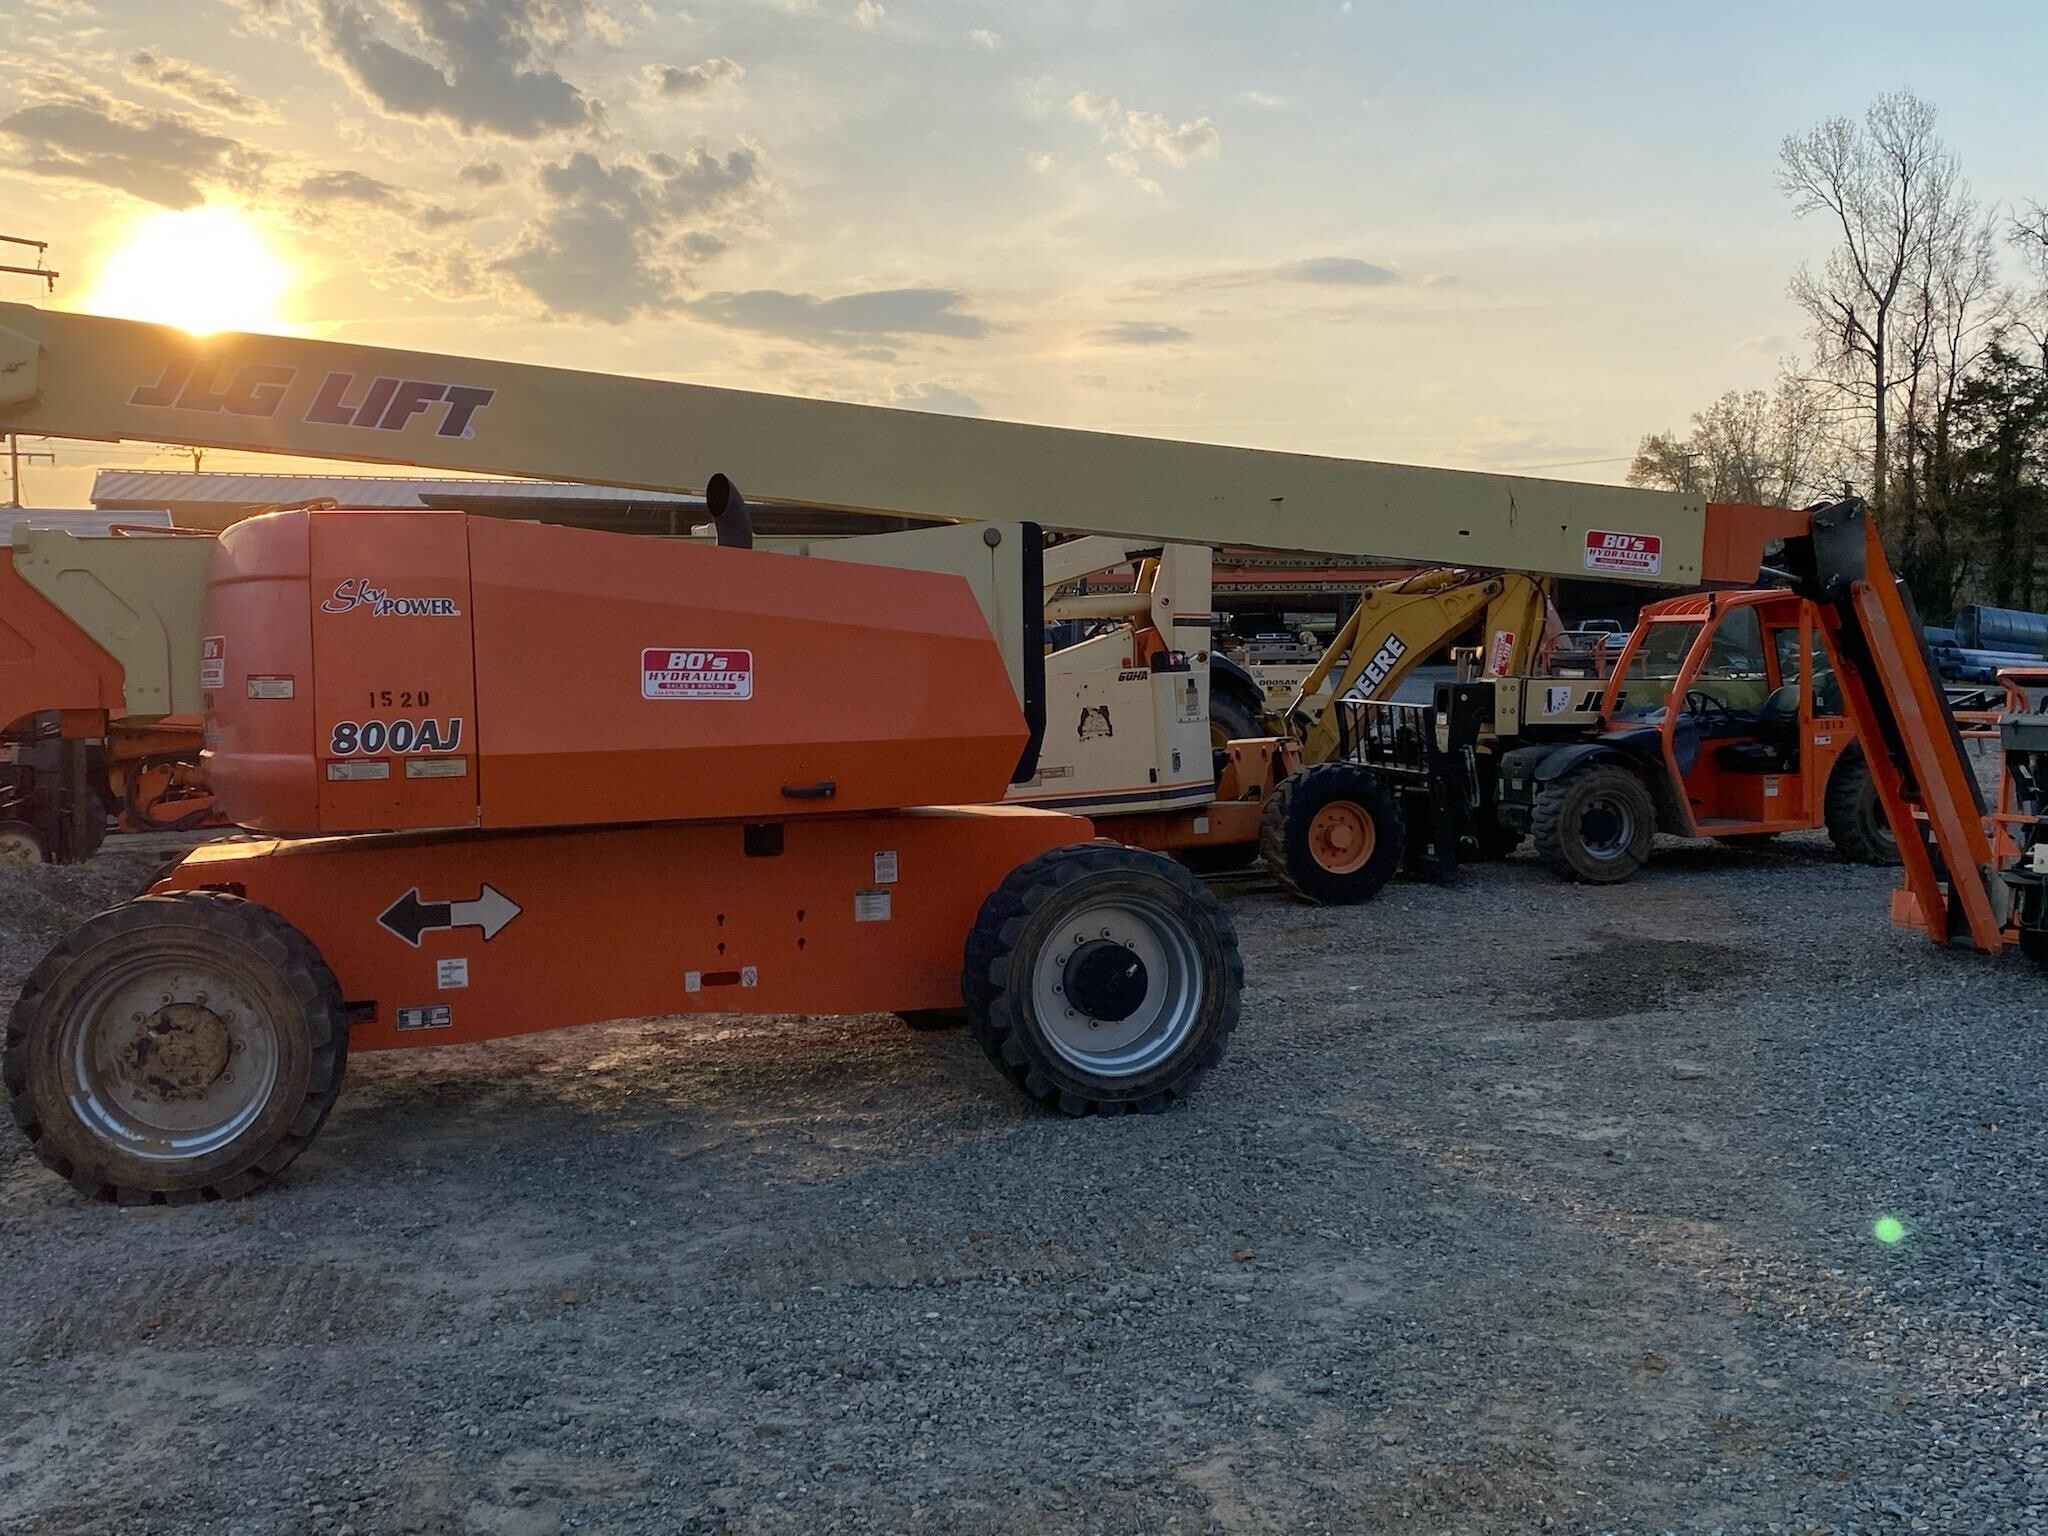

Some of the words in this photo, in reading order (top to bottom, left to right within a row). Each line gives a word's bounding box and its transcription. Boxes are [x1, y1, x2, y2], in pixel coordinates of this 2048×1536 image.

[126, 356, 299, 419] JLG
[303, 371, 497, 438] LIFT
[1603, 534, 1646, 551] BO's
[1589, 548, 1657, 561] HYDRAULICS
[667, 652, 728, 670] BO's
[648, 672, 746, 682] HYDRAULICS
[1118, 671, 1148, 681] 60HA
[1342, 635, 1406, 710] DEERE
[368, 690, 430, 708] 1520
[330, 718, 463, 755] 800AJ
